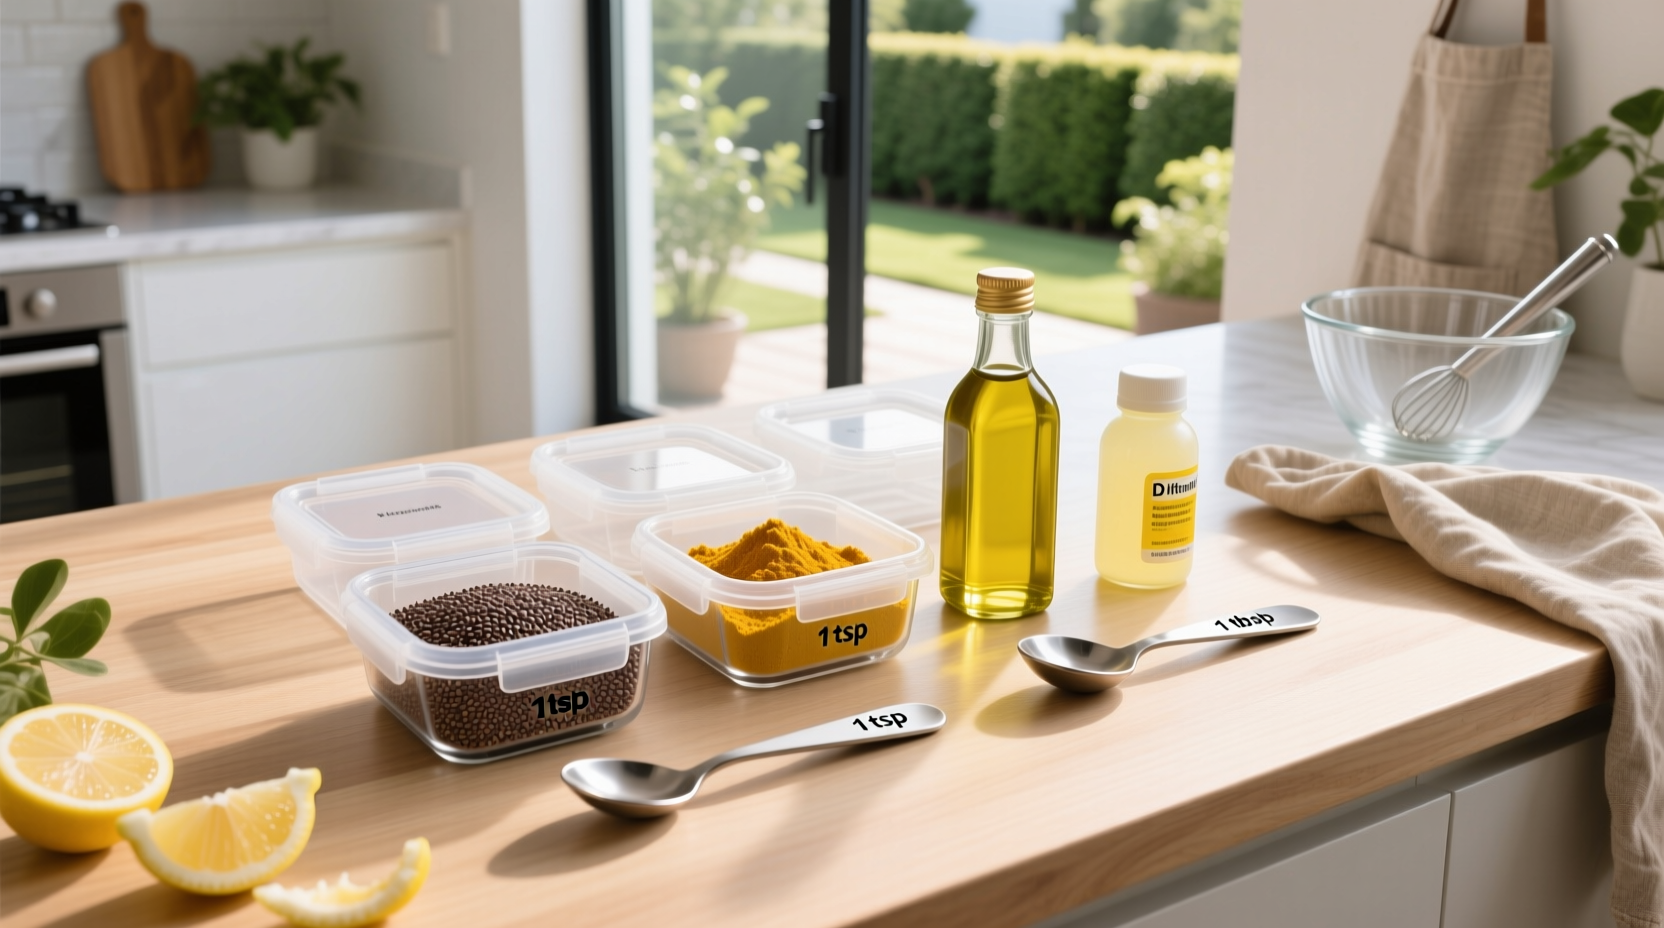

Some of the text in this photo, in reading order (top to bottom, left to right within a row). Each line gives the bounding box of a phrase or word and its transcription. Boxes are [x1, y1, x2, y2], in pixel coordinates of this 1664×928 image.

[1214, 619, 1230, 631] 1
[818, 622, 868, 648] 1 tsp
[852, 712, 908, 731] 1 tsp
